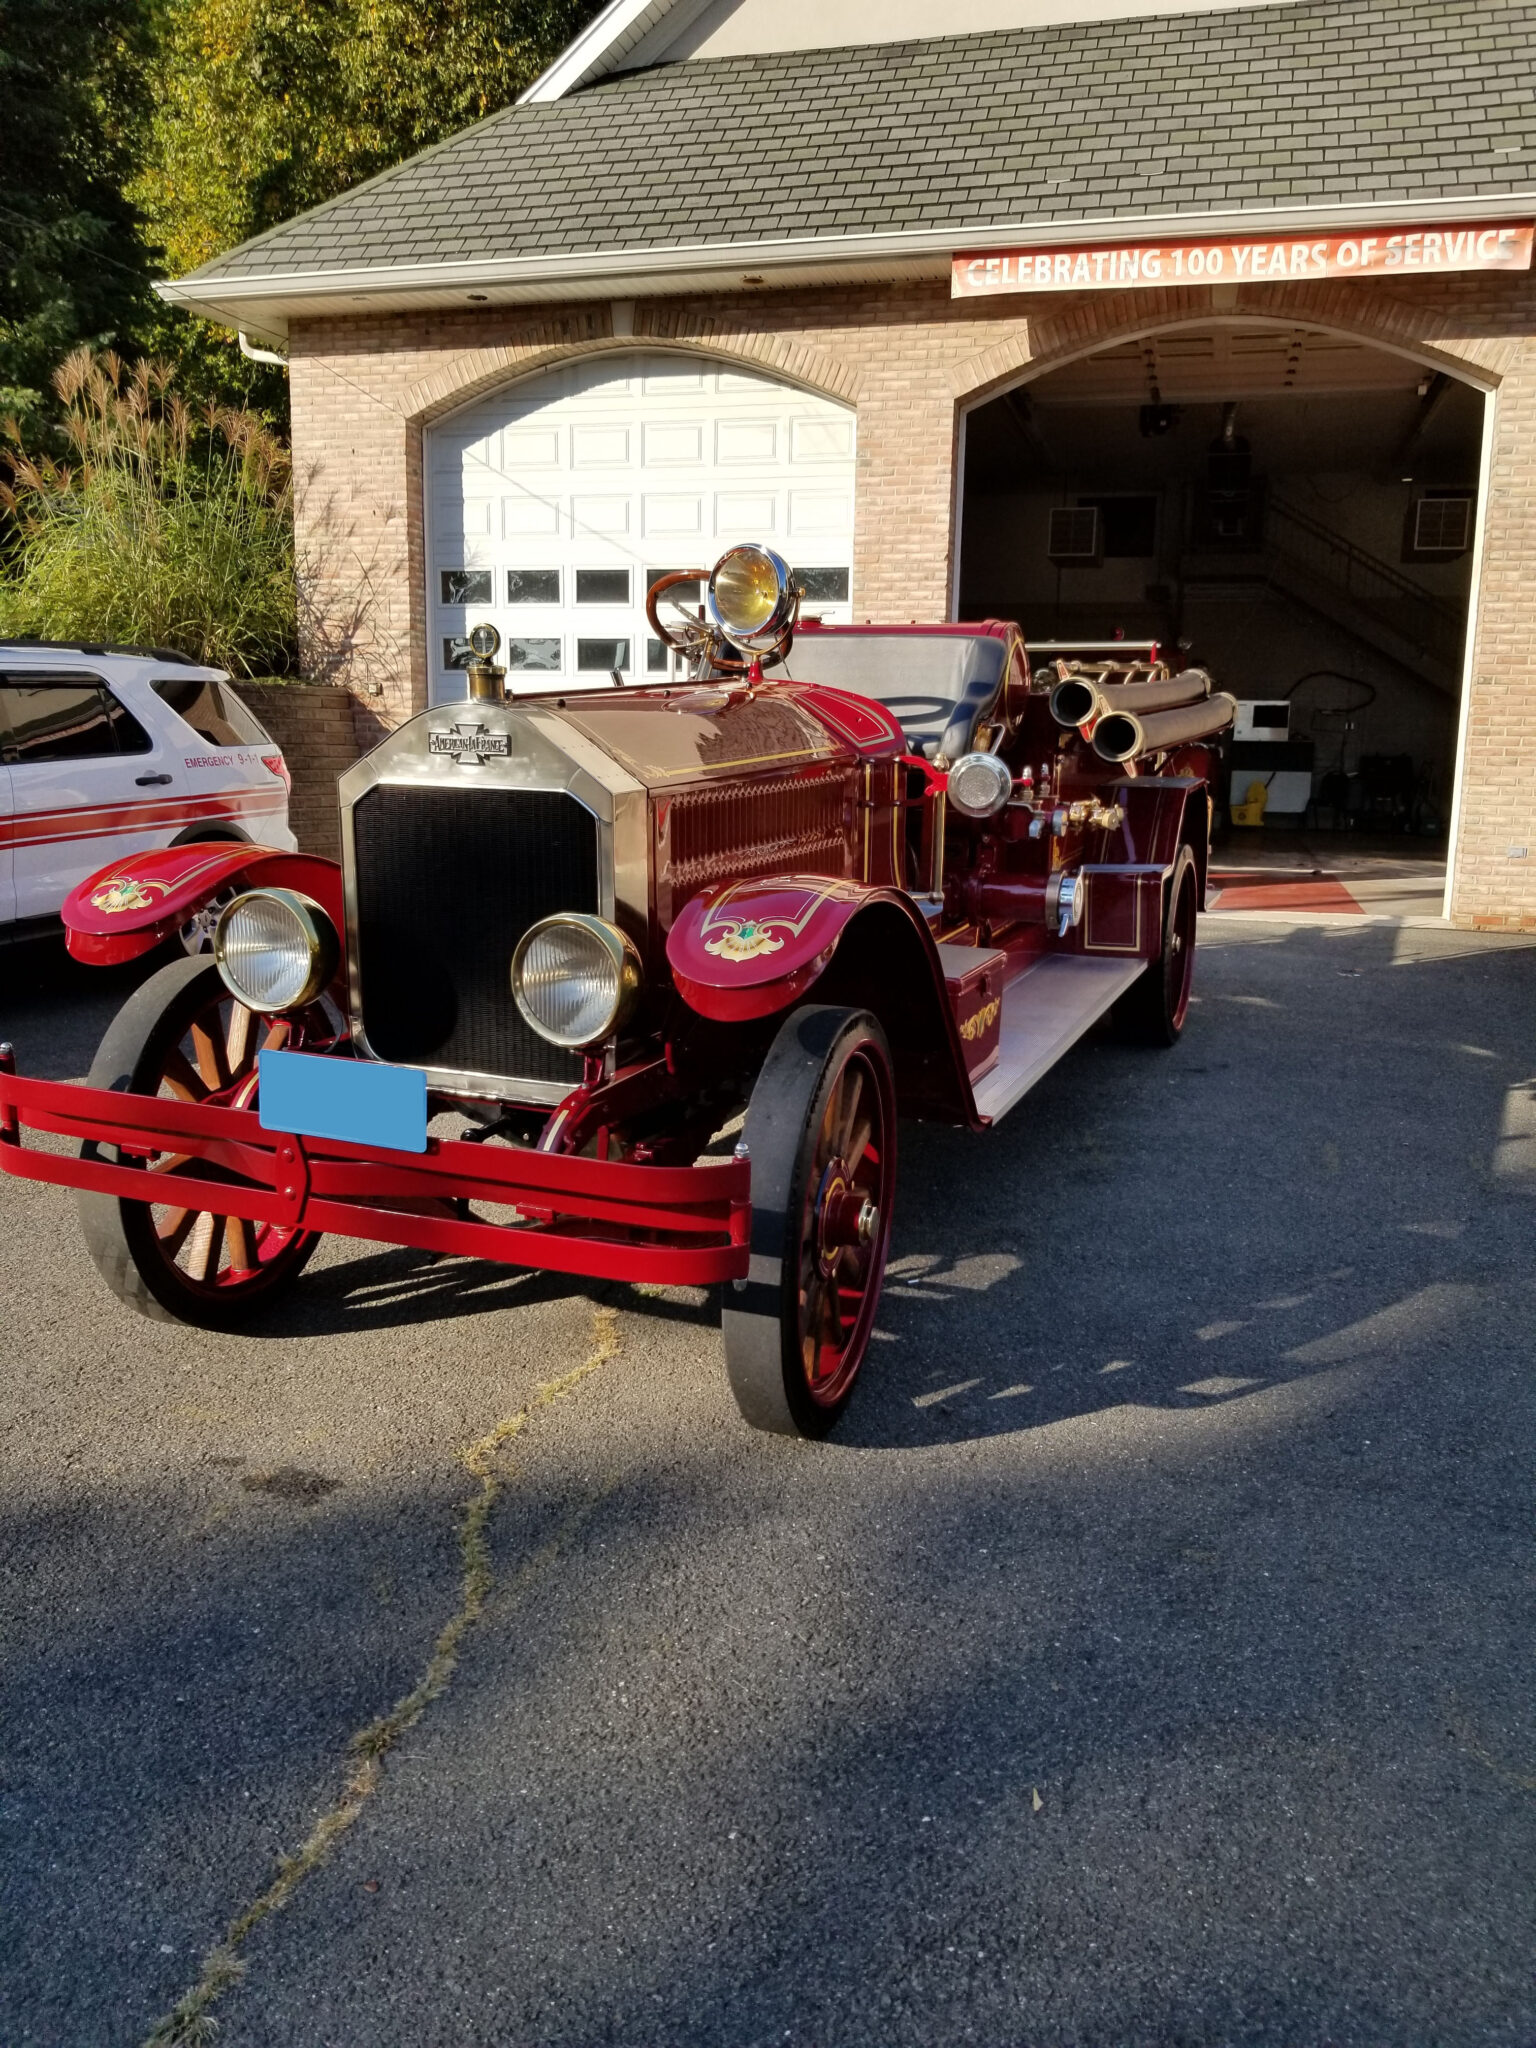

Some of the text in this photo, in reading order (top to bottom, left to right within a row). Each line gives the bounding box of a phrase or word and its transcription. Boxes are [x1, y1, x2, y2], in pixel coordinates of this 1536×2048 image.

[967, 229, 1516, 287] CELEBRATING 100 YEARS OF SERVICE
[184, 753, 260, 769] EMERGENCY 9-1-1
